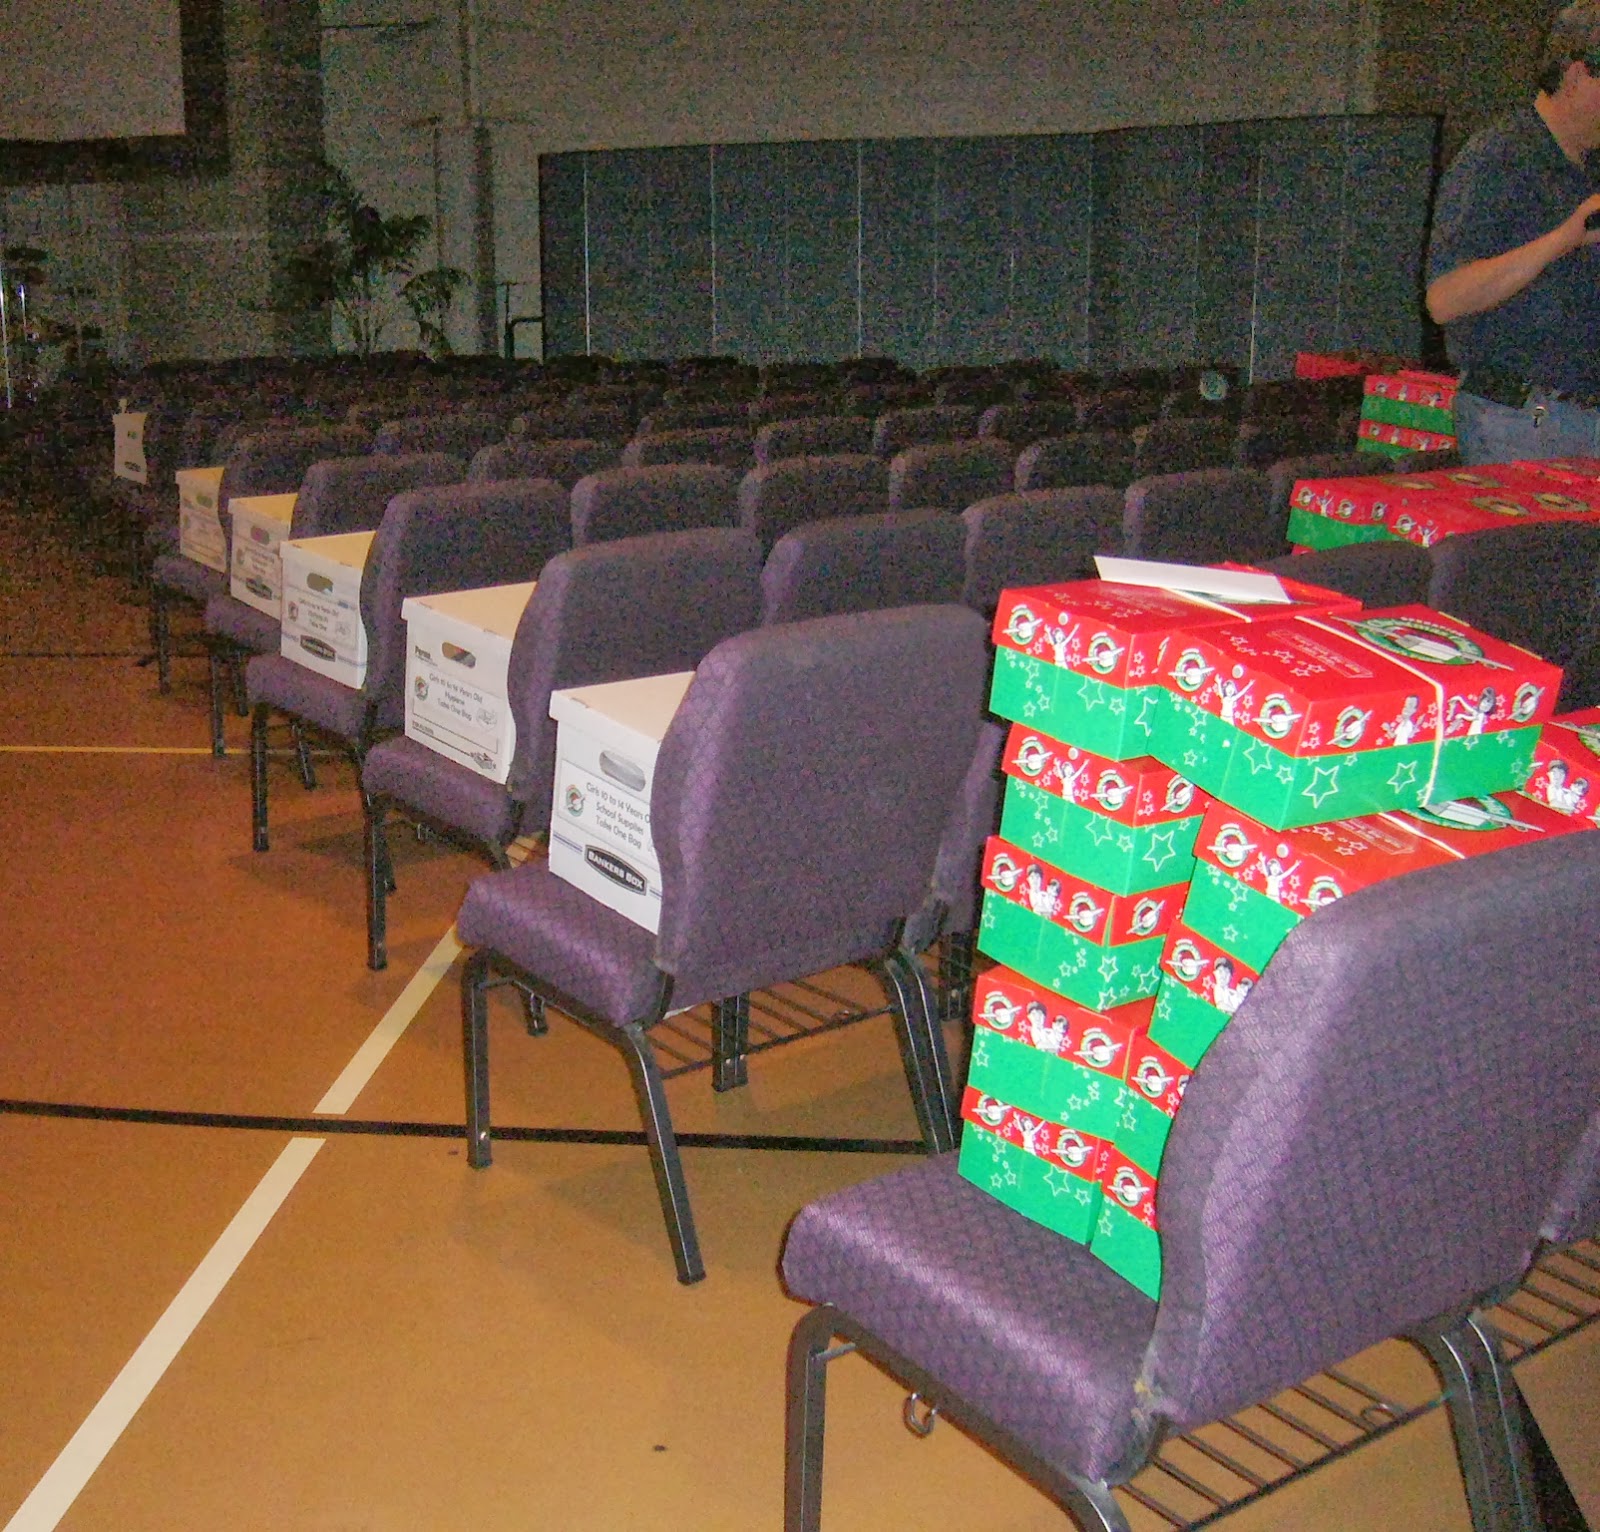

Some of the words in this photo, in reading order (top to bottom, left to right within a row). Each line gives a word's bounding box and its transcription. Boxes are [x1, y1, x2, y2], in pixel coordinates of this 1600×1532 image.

[586, 782, 600, 797] Girls
[609, 794, 617, 806] to
[625, 802, 644, 821] Years
[596, 801, 617, 819] School
[596, 814, 612, 832] Take
[613, 825, 627, 841] One
[628, 833, 642, 850] Bag
[588, 850, 625, 878] BANKERS
[625, 872, 643, 889] BOX
